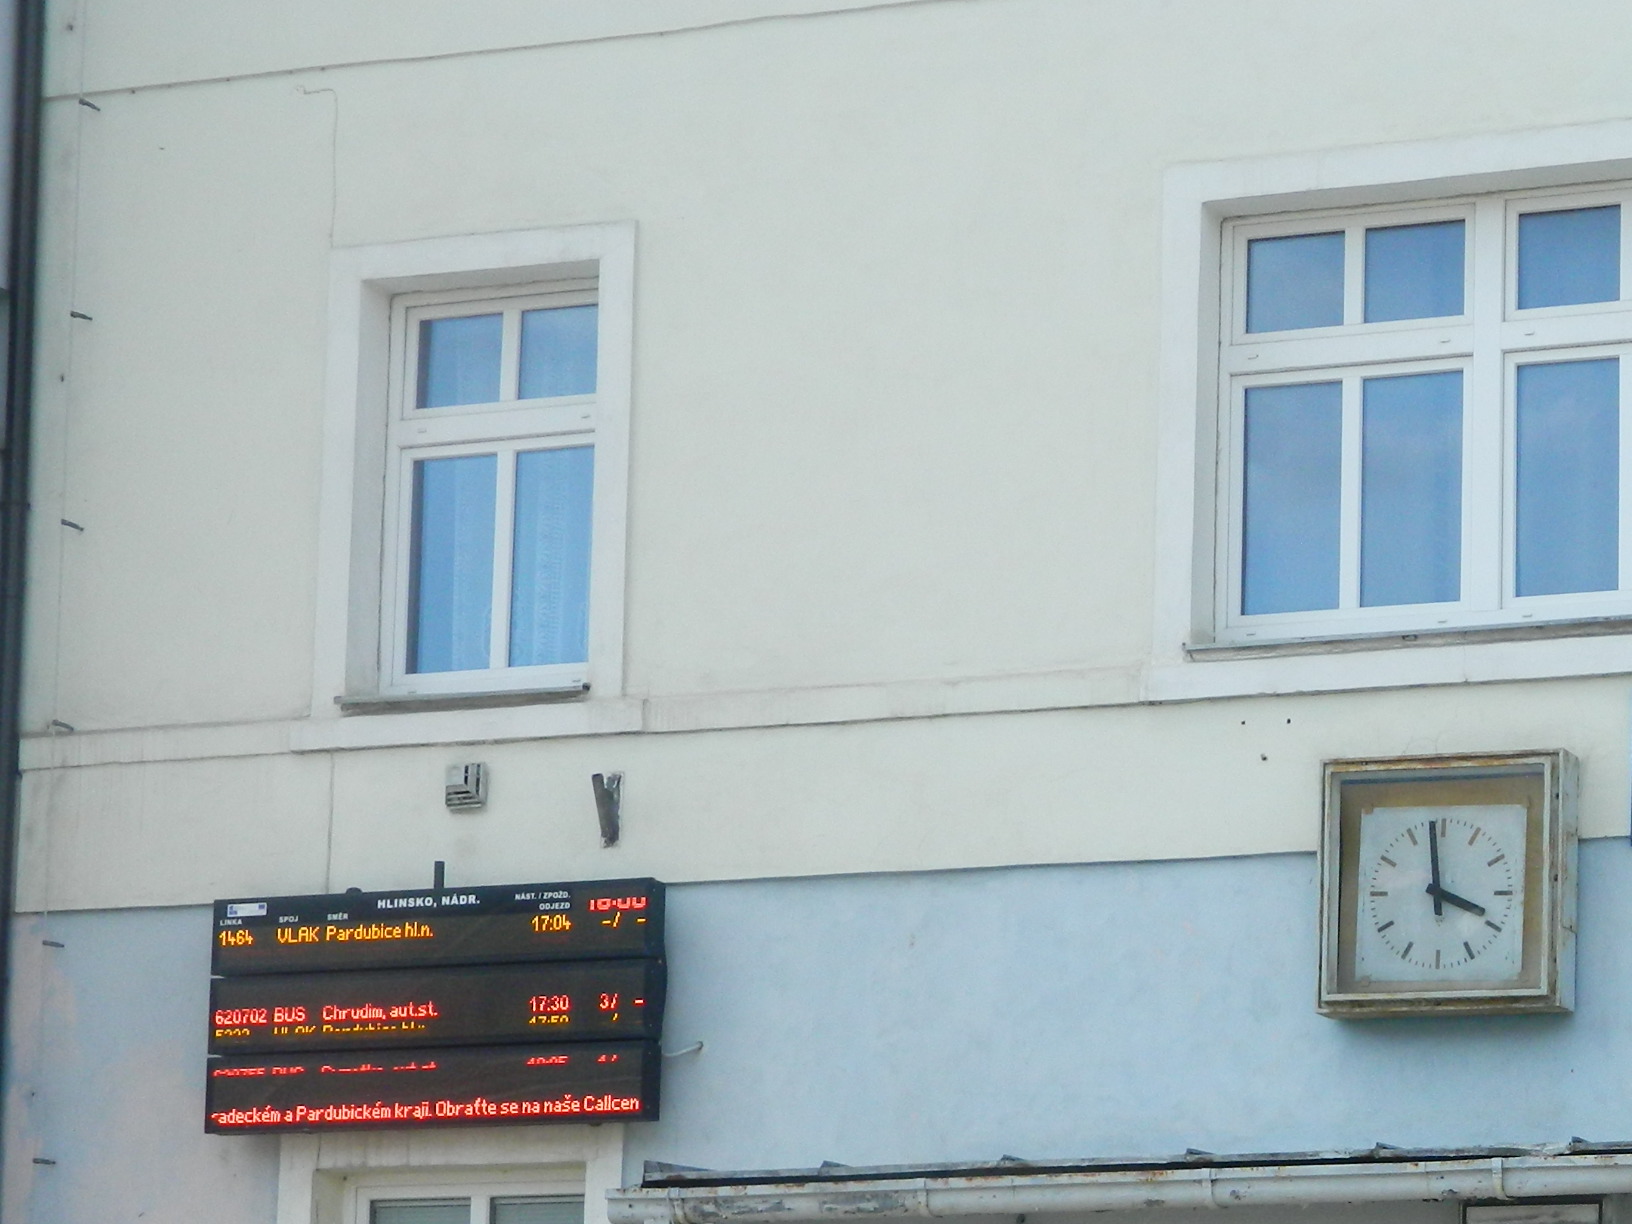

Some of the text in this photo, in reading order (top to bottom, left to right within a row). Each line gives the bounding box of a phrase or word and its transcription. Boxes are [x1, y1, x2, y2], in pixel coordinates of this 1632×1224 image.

[377, 893, 481, 909] HLINSKO, NÁDR.
[539, 901, 571, 911] ODJEZD
[219, 911, 349, 927] LINKA SPOJ SMĚR
[219, 929, 254, 946] 1464
[277, 926, 320, 943] VLAK
[326, 923, 402, 941] Pardubice
[404, 921, 434, 938] hl.n.
[531, 914, 572, 932] 17:04
[215, 1008, 268, 1025] 620702
[273, 1006, 306, 1023] BUS
[322, 1003, 386, 1021] Chrudim,
[389, 1001, 438, 1018] aut.st.
[529, 994, 570, 1012] 17:30
[284, 1110, 293, 1122] a
[296, 1101, 391, 1122] Pardubickém
[394, 1101, 433, 1120] kraji.
[435, 1097, 497, 1117] Obraťte
[500, 1101, 519, 1115] se
[522, 1101, 540, 1114] na
[544, 1094, 580, 1113] naše
[583, 1094, 640, 1112] Callcen
